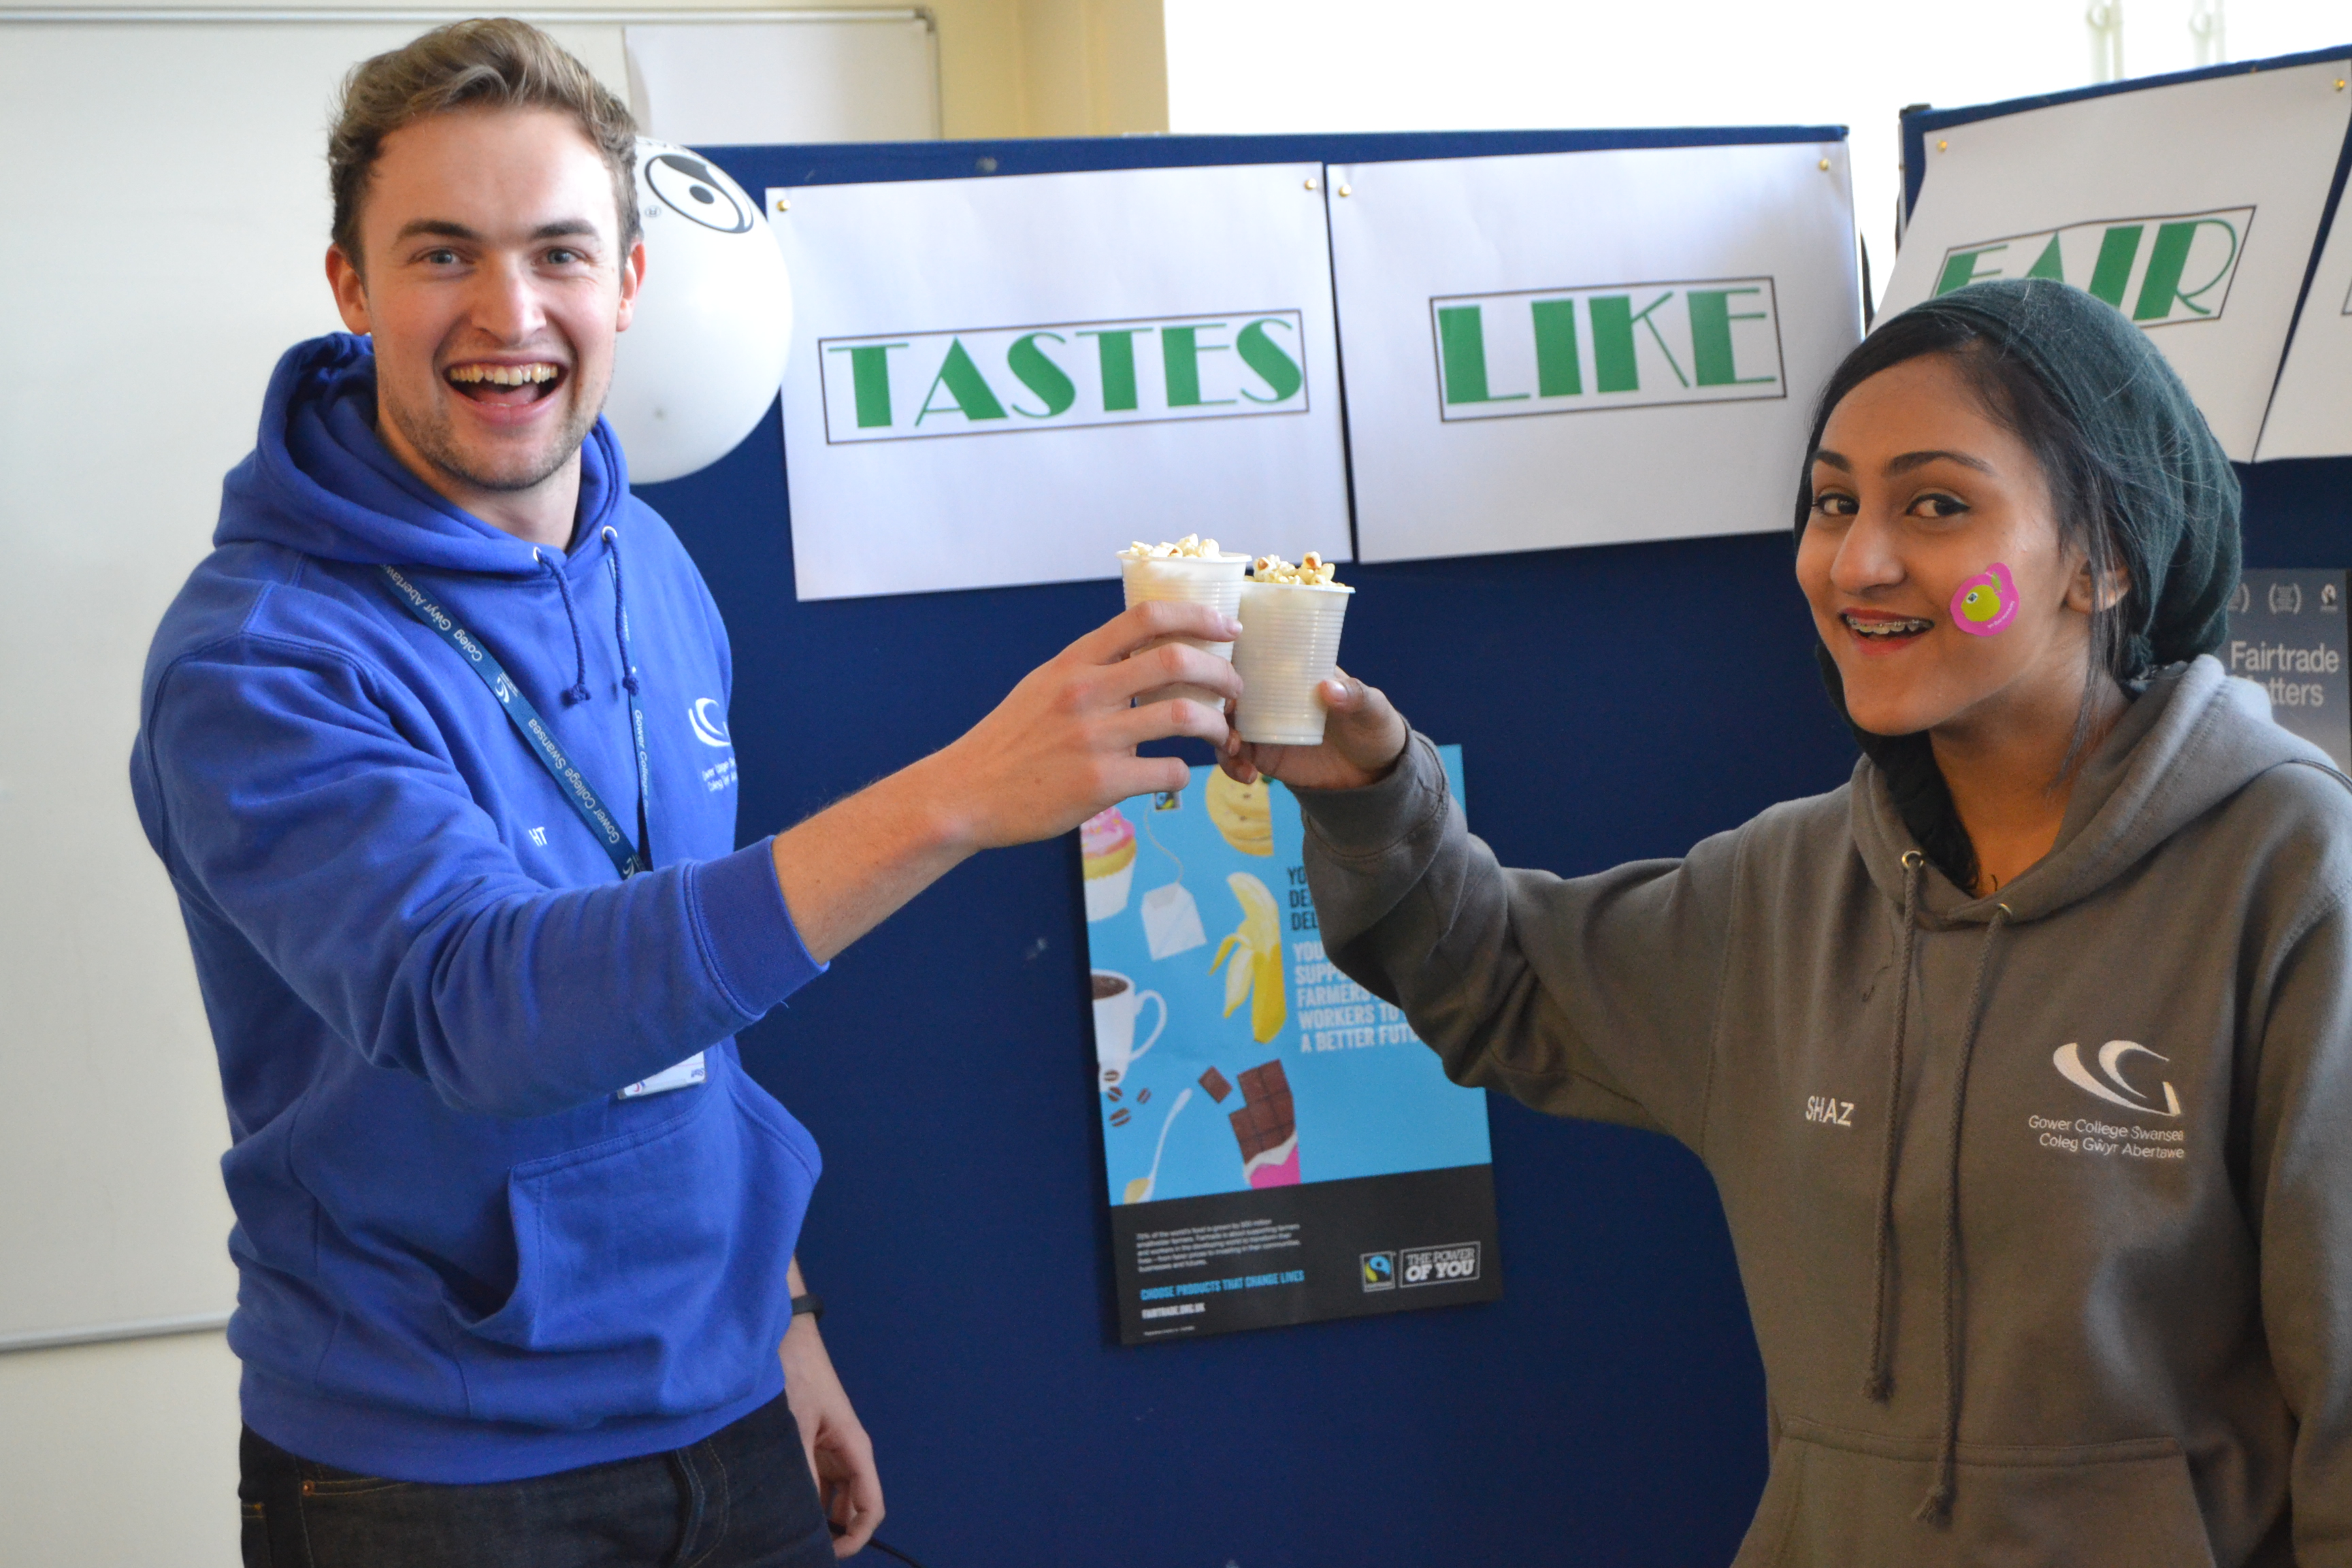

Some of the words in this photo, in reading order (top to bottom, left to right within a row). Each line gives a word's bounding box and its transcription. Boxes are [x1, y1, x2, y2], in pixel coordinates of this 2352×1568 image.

[1437, 287, 1777, 404] LIKE
[828, 318, 1303, 428] TASTES
[453, 629, 483, 662] Coleg
[2231, 640, 2340, 674] Fairtrade
[2234, 675, 2325, 707] tters
[528, 718, 567, 770] Swansea
[634, 709, 645, 749] Gower
[565, 768, 596, 810] College
[593, 808, 620, 845] Gower
[1298, 1004, 1375, 1030] WORKERS
[1301, 1033, 1313, 1053] A
[1316, 1027, 1375, 1052] BETTER
[1806, 1096, 1855, 1126] SHAZ
[2029, 1115, 2072, 1130] Gower
[2075, 1119, 2128, 1139] College
[2131, 1126, 2184, 1141] Swansea
[2040, 1132, 2078, 1152] Coleg
[2122, 1143, 2185, 1158] Abertawe
[1405, 1264, 1433, 1282] OF
[1435, 1259, 1475, 1278] YOU
[1406, 1252, 1433, 1265] THE
[1433, 1247, 1475, 1262] POWER
